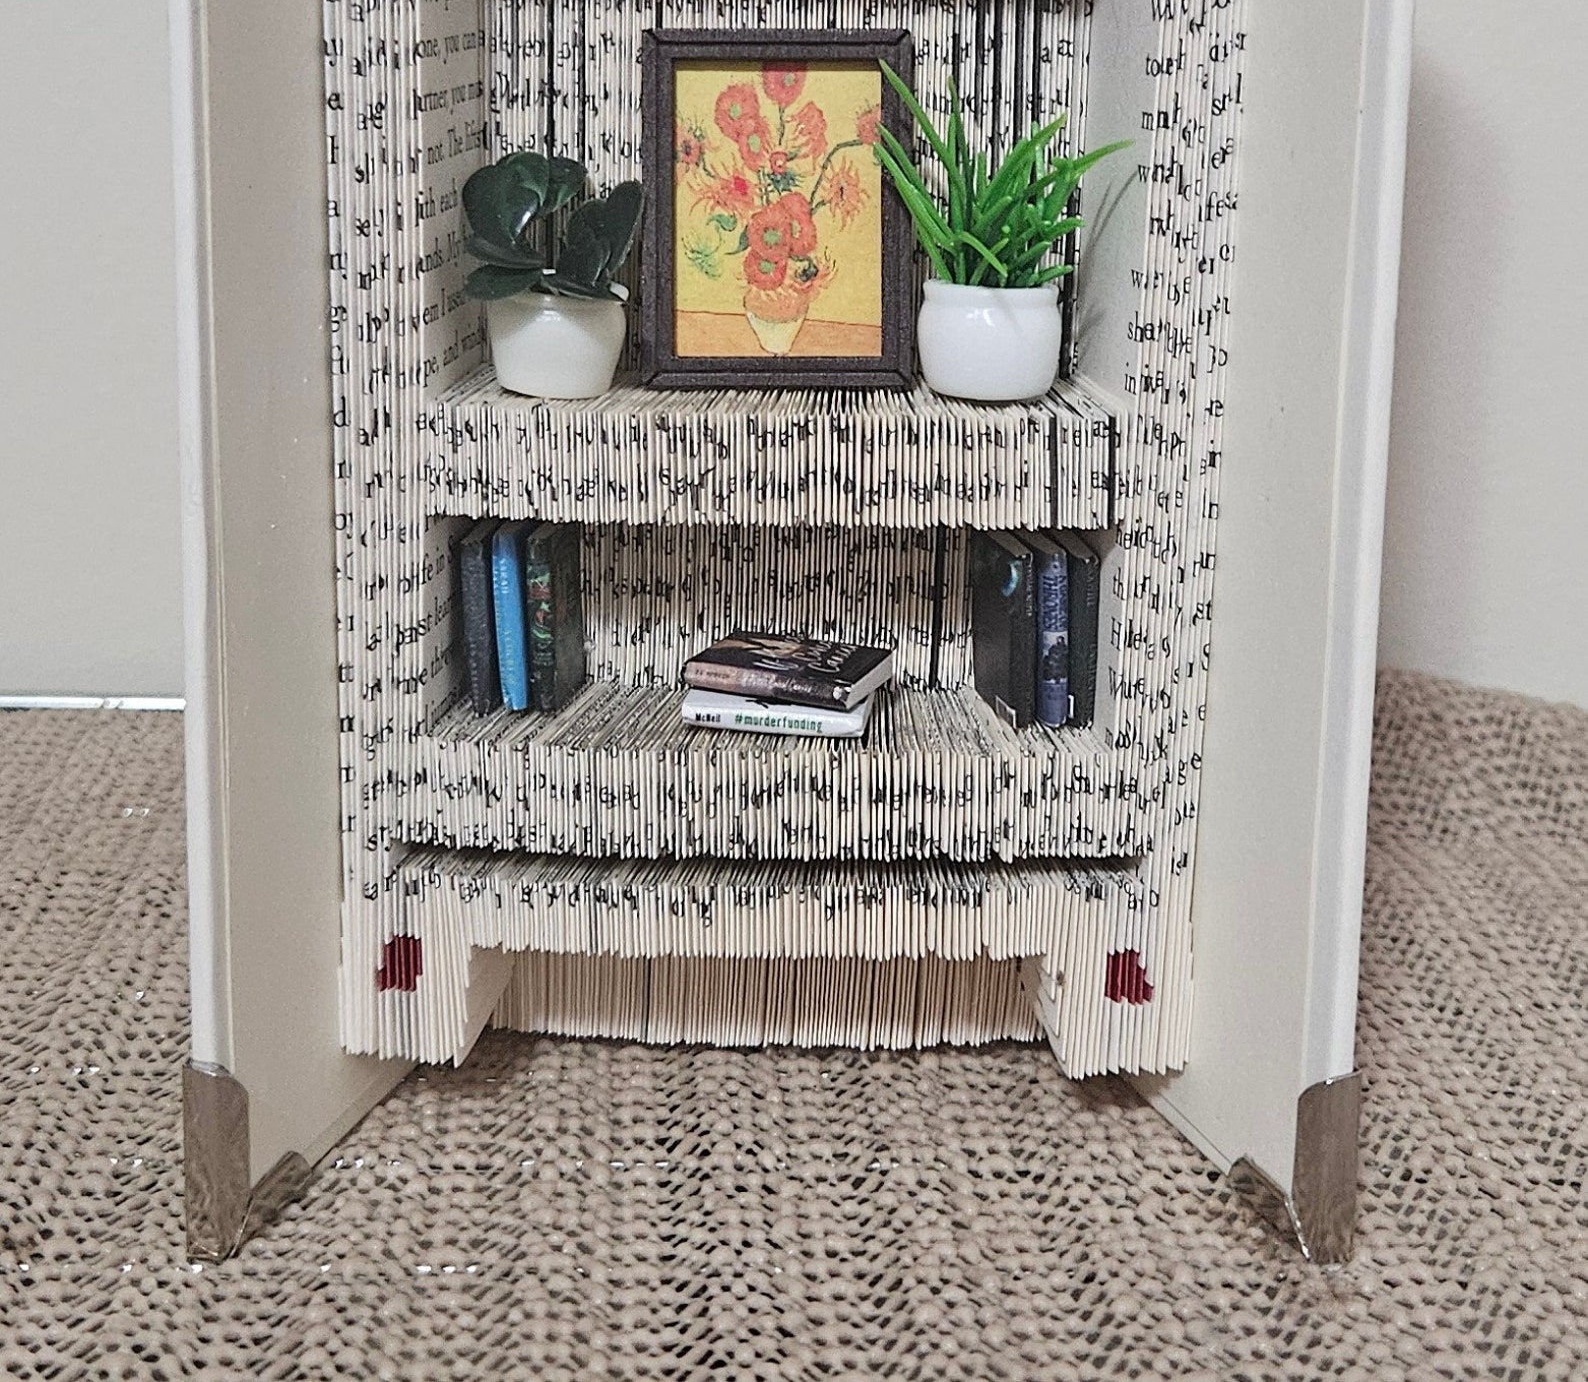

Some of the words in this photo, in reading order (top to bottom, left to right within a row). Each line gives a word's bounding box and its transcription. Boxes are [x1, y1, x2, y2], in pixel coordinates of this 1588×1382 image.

[443, 34, 460, 65] you
[695, 712, 721, 723] McNeil
[734, 713, 823, 734] #murderfunding
